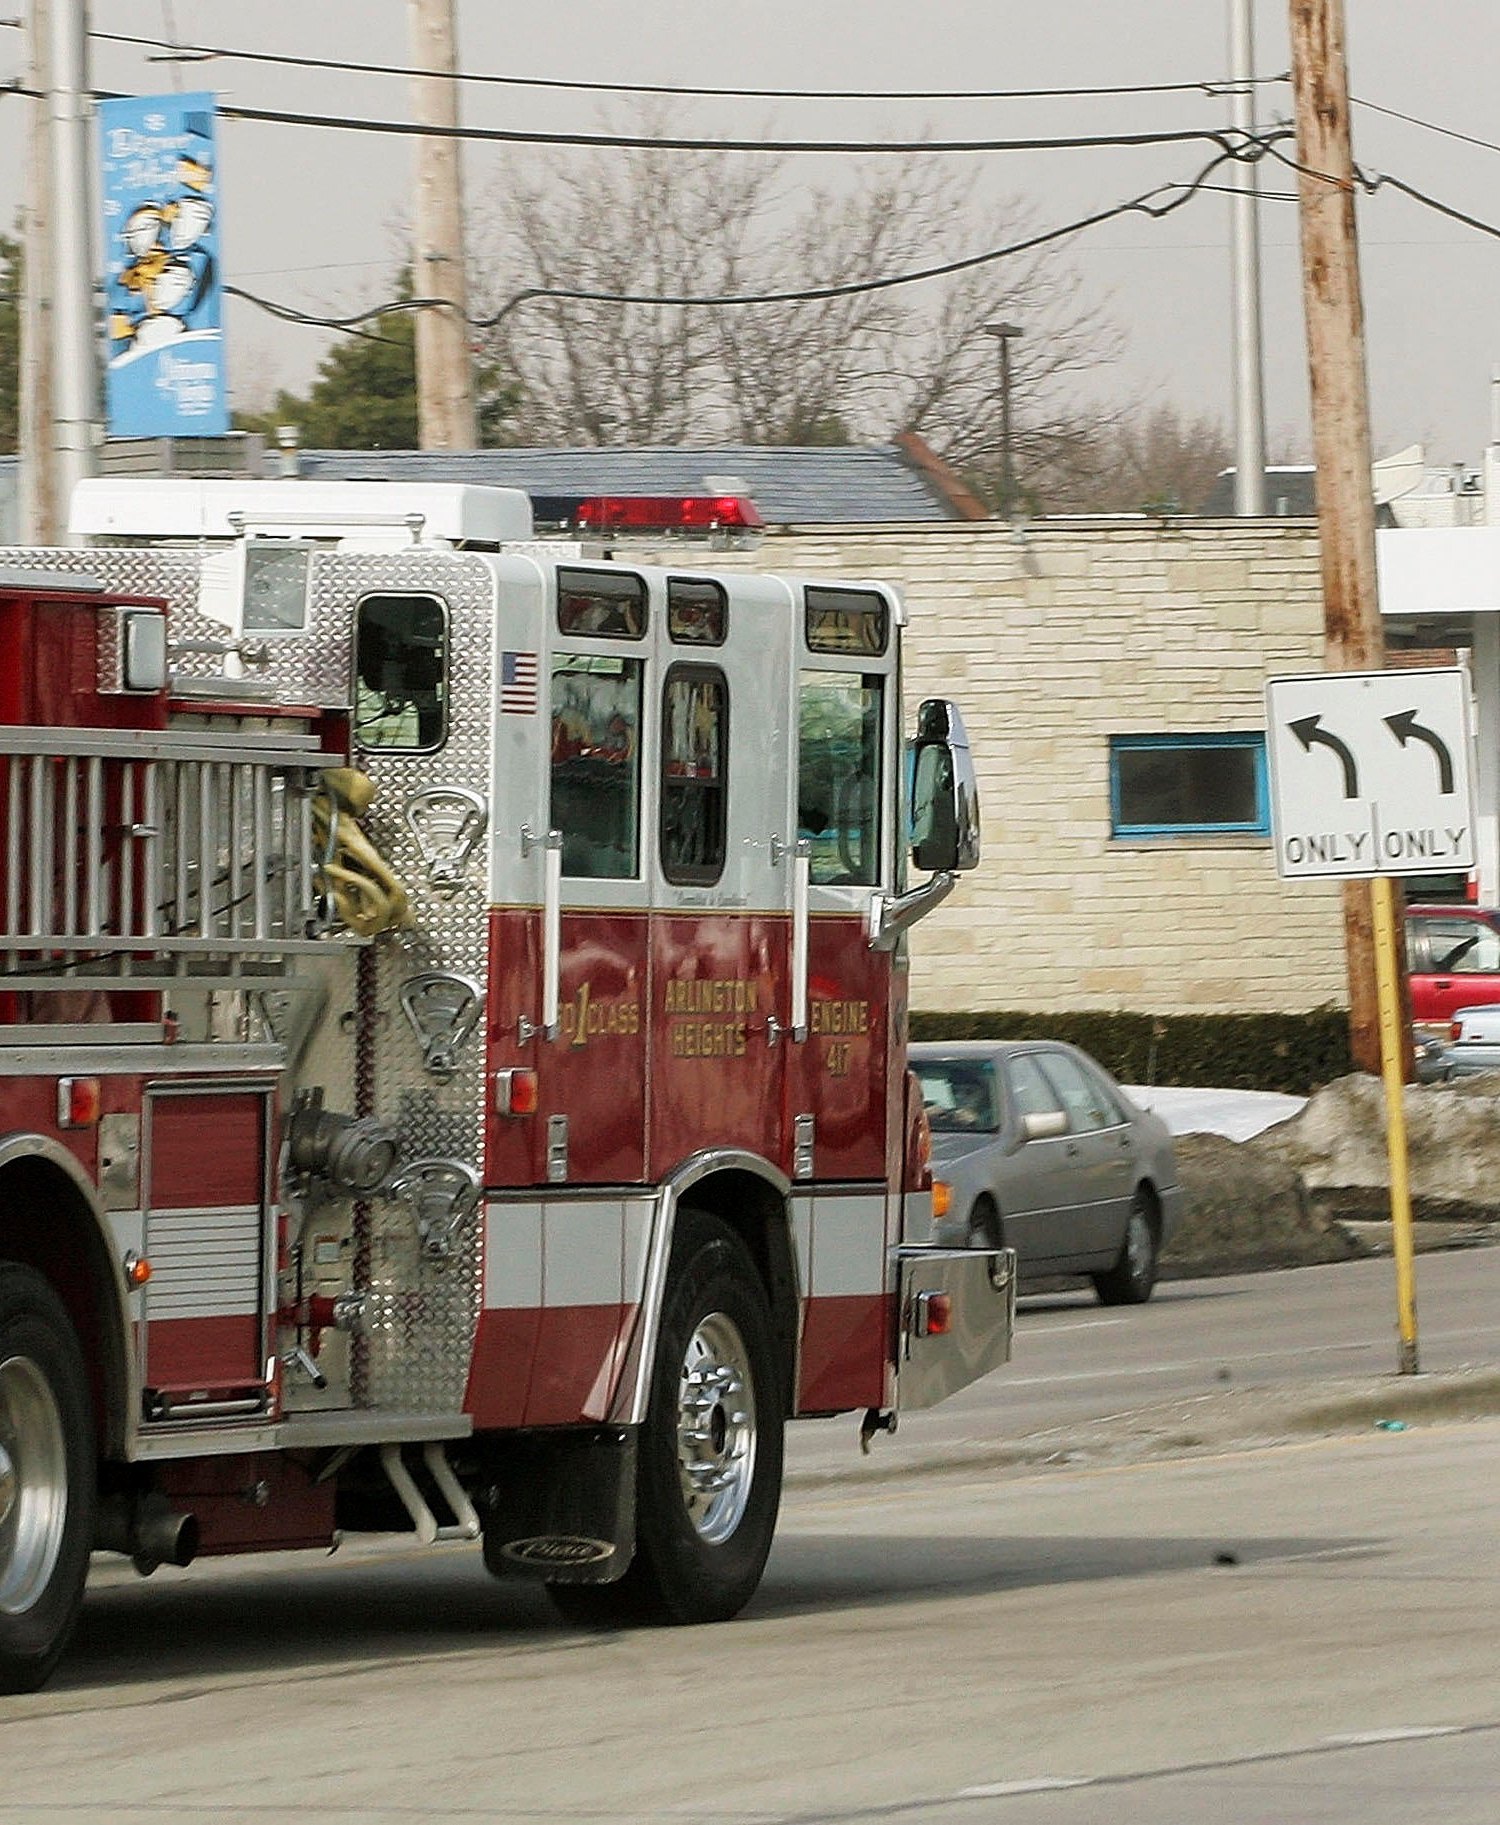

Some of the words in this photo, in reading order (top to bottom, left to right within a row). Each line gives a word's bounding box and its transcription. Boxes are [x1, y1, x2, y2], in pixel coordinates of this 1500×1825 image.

[1286, 832, 1369, 864] ONLY
[1385, 827, 1467, 859] ONLY
[665, 980, 758, 1013] ARLINGTON
[811, 1001, 869, 1033] ENGINE
[673, 1023, 747, 1057] HEIGHTS
